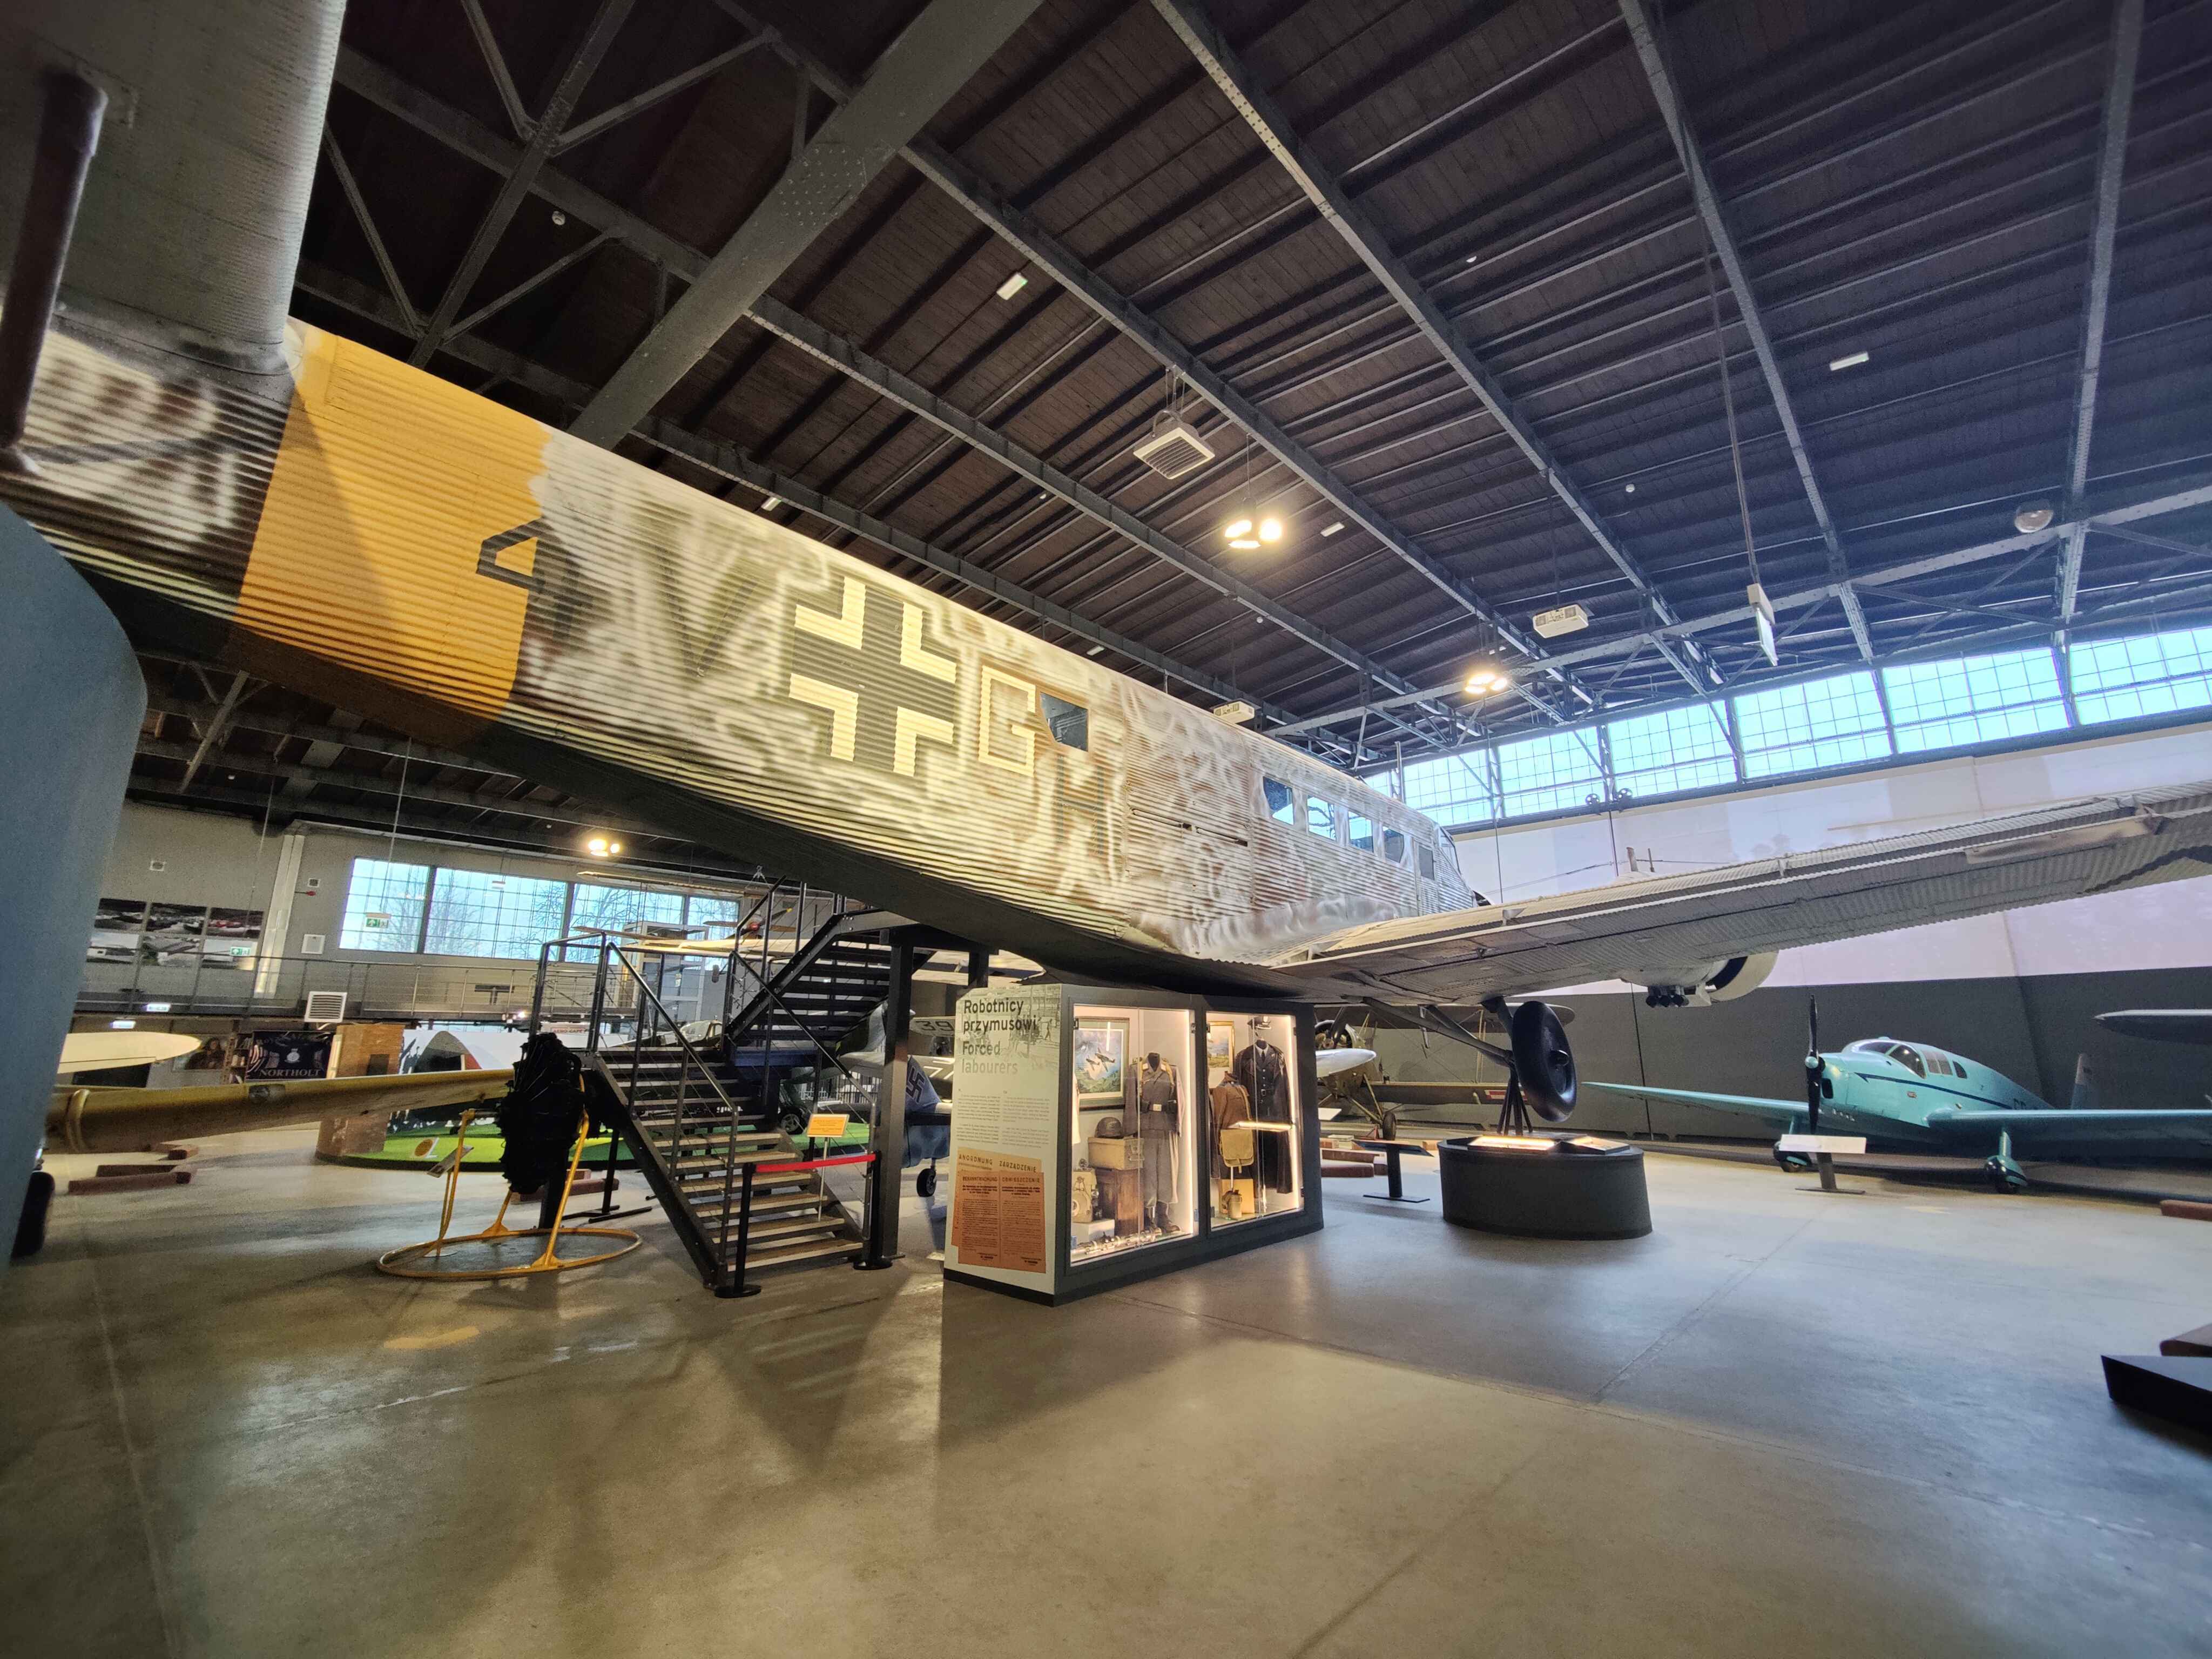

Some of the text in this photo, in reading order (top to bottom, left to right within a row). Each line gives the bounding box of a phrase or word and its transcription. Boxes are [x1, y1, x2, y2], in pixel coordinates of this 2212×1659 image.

[979, 665, 1036, 777] G
[964, 997, 1024, 1015] Robotnicy
[963, 1015, 1036, 1035] przymusowi
[962, 1041, 1001, 1055] Forced
[962, 1058, 1019, 1074] labourers
